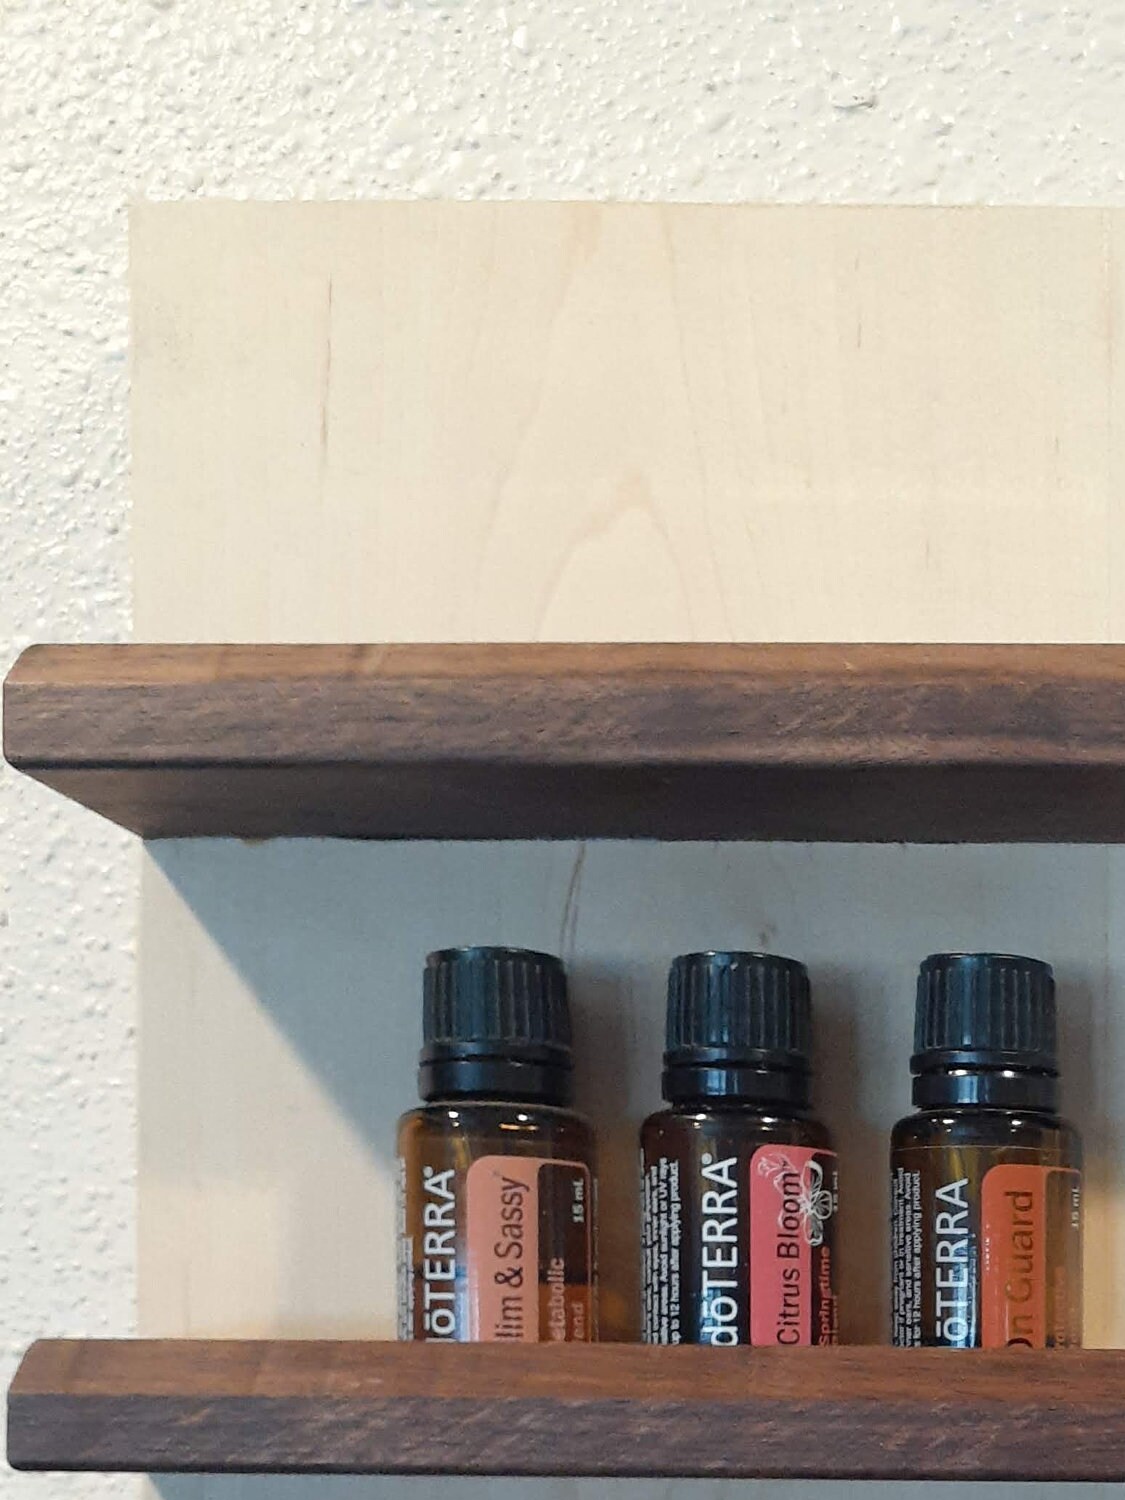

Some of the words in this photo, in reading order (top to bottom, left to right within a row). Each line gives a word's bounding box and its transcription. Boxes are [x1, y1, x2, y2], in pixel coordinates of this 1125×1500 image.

[660, 1182, 669, 1199] UV
[494, 1176, 529, 1259] Sassy
[670, 1203, 681, 1246] applying
[777, 1170, 801, 1259] Bloom
[912, 1212, 922, 1254] applying
[1004, 1191, 1033, 1303] Guard
[494, 1267, 523, 1287] &
[670, 1248, 681, 1271] after
[912, 1257, 922, 1279] after
[935, 1178, 969, 1347] ōTERRA
[547, 1257, 566, 1341] etabolic
[670, 1273, 681, 1302] hours
[912, 1281, 922, 1308] hours
[495, 1296, 524, 1342] lim
[670, 1304, 681, 1317] 12
[670, 1319, 681, 1330] to
[777, 1269, 800, 1346] Citrus
[912, 1310, 922, 1322] 12
